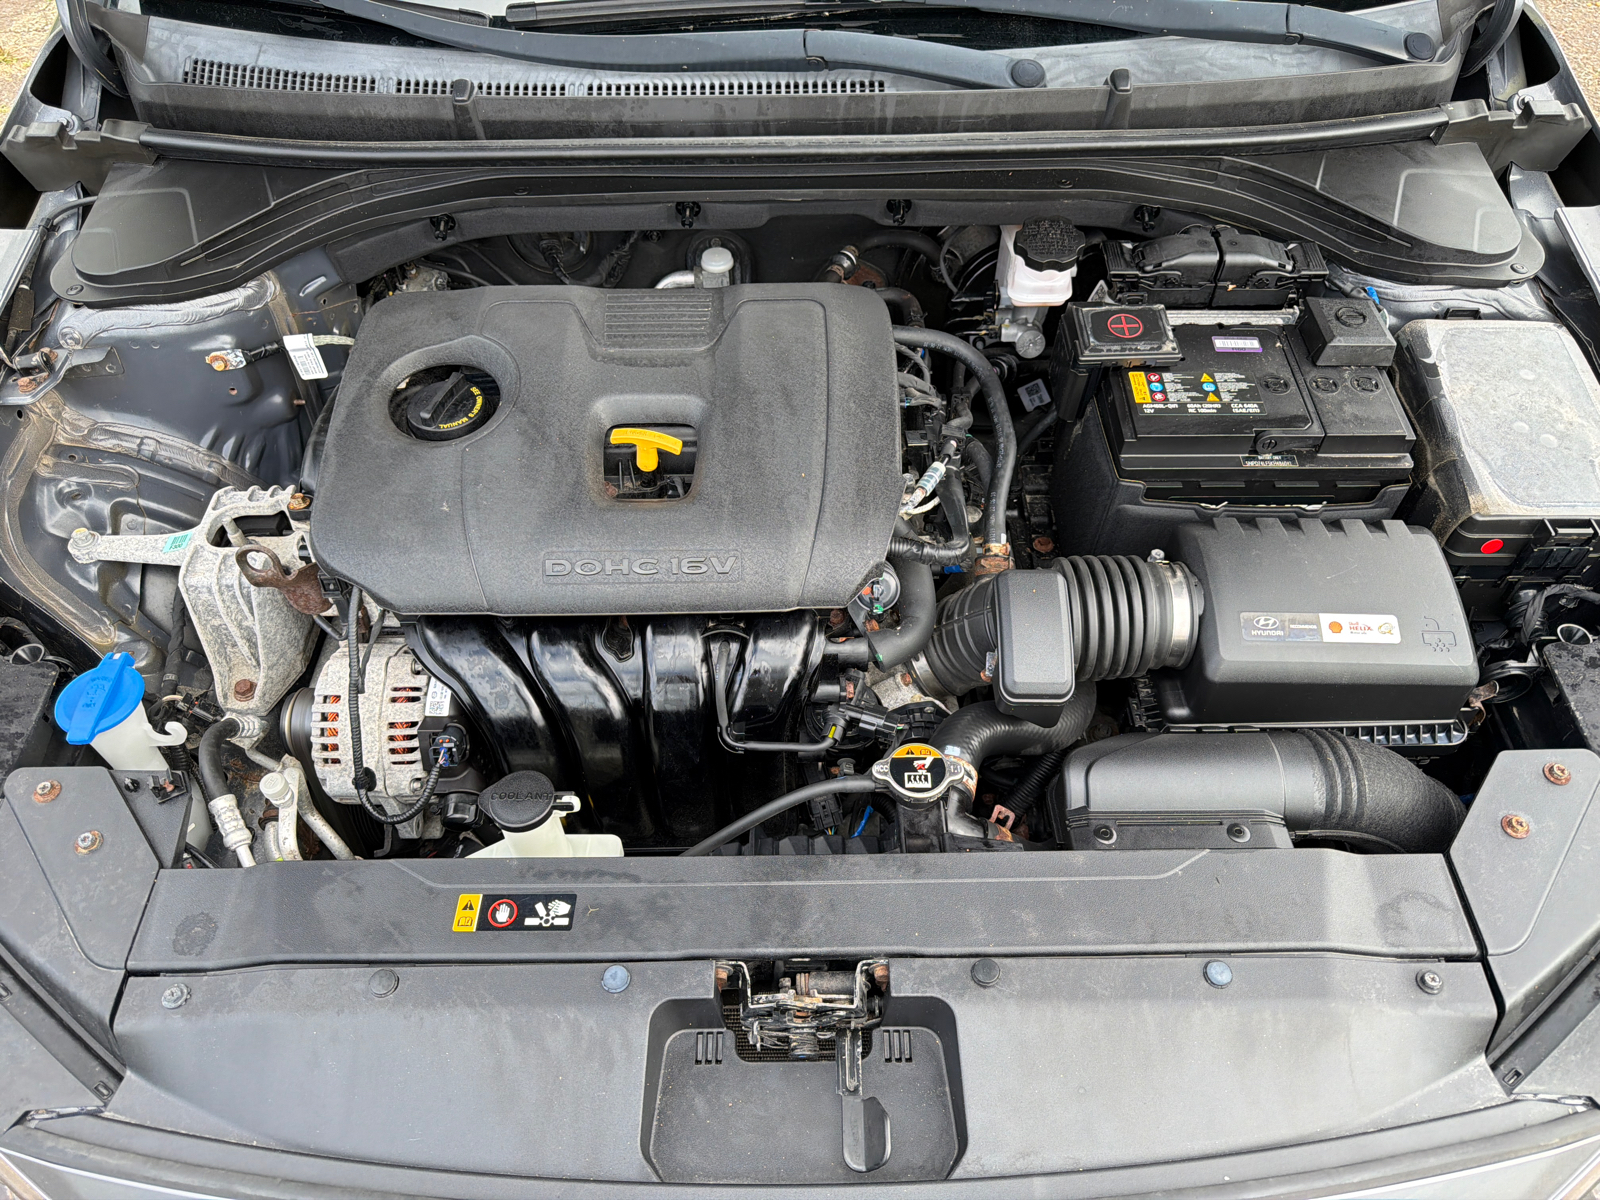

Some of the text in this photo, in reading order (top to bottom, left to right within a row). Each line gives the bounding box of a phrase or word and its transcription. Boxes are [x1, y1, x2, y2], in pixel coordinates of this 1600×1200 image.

[438, 386, 483, 429] SEE OWNER'S MANUAL
[544, 556, 738, 577] DOHC 16V
[1251, 629, 1285, 637] HYUNDAI
[874, 764, 962, 773] HCC 1.1
[489, 790, 554, 802] COOLANT
